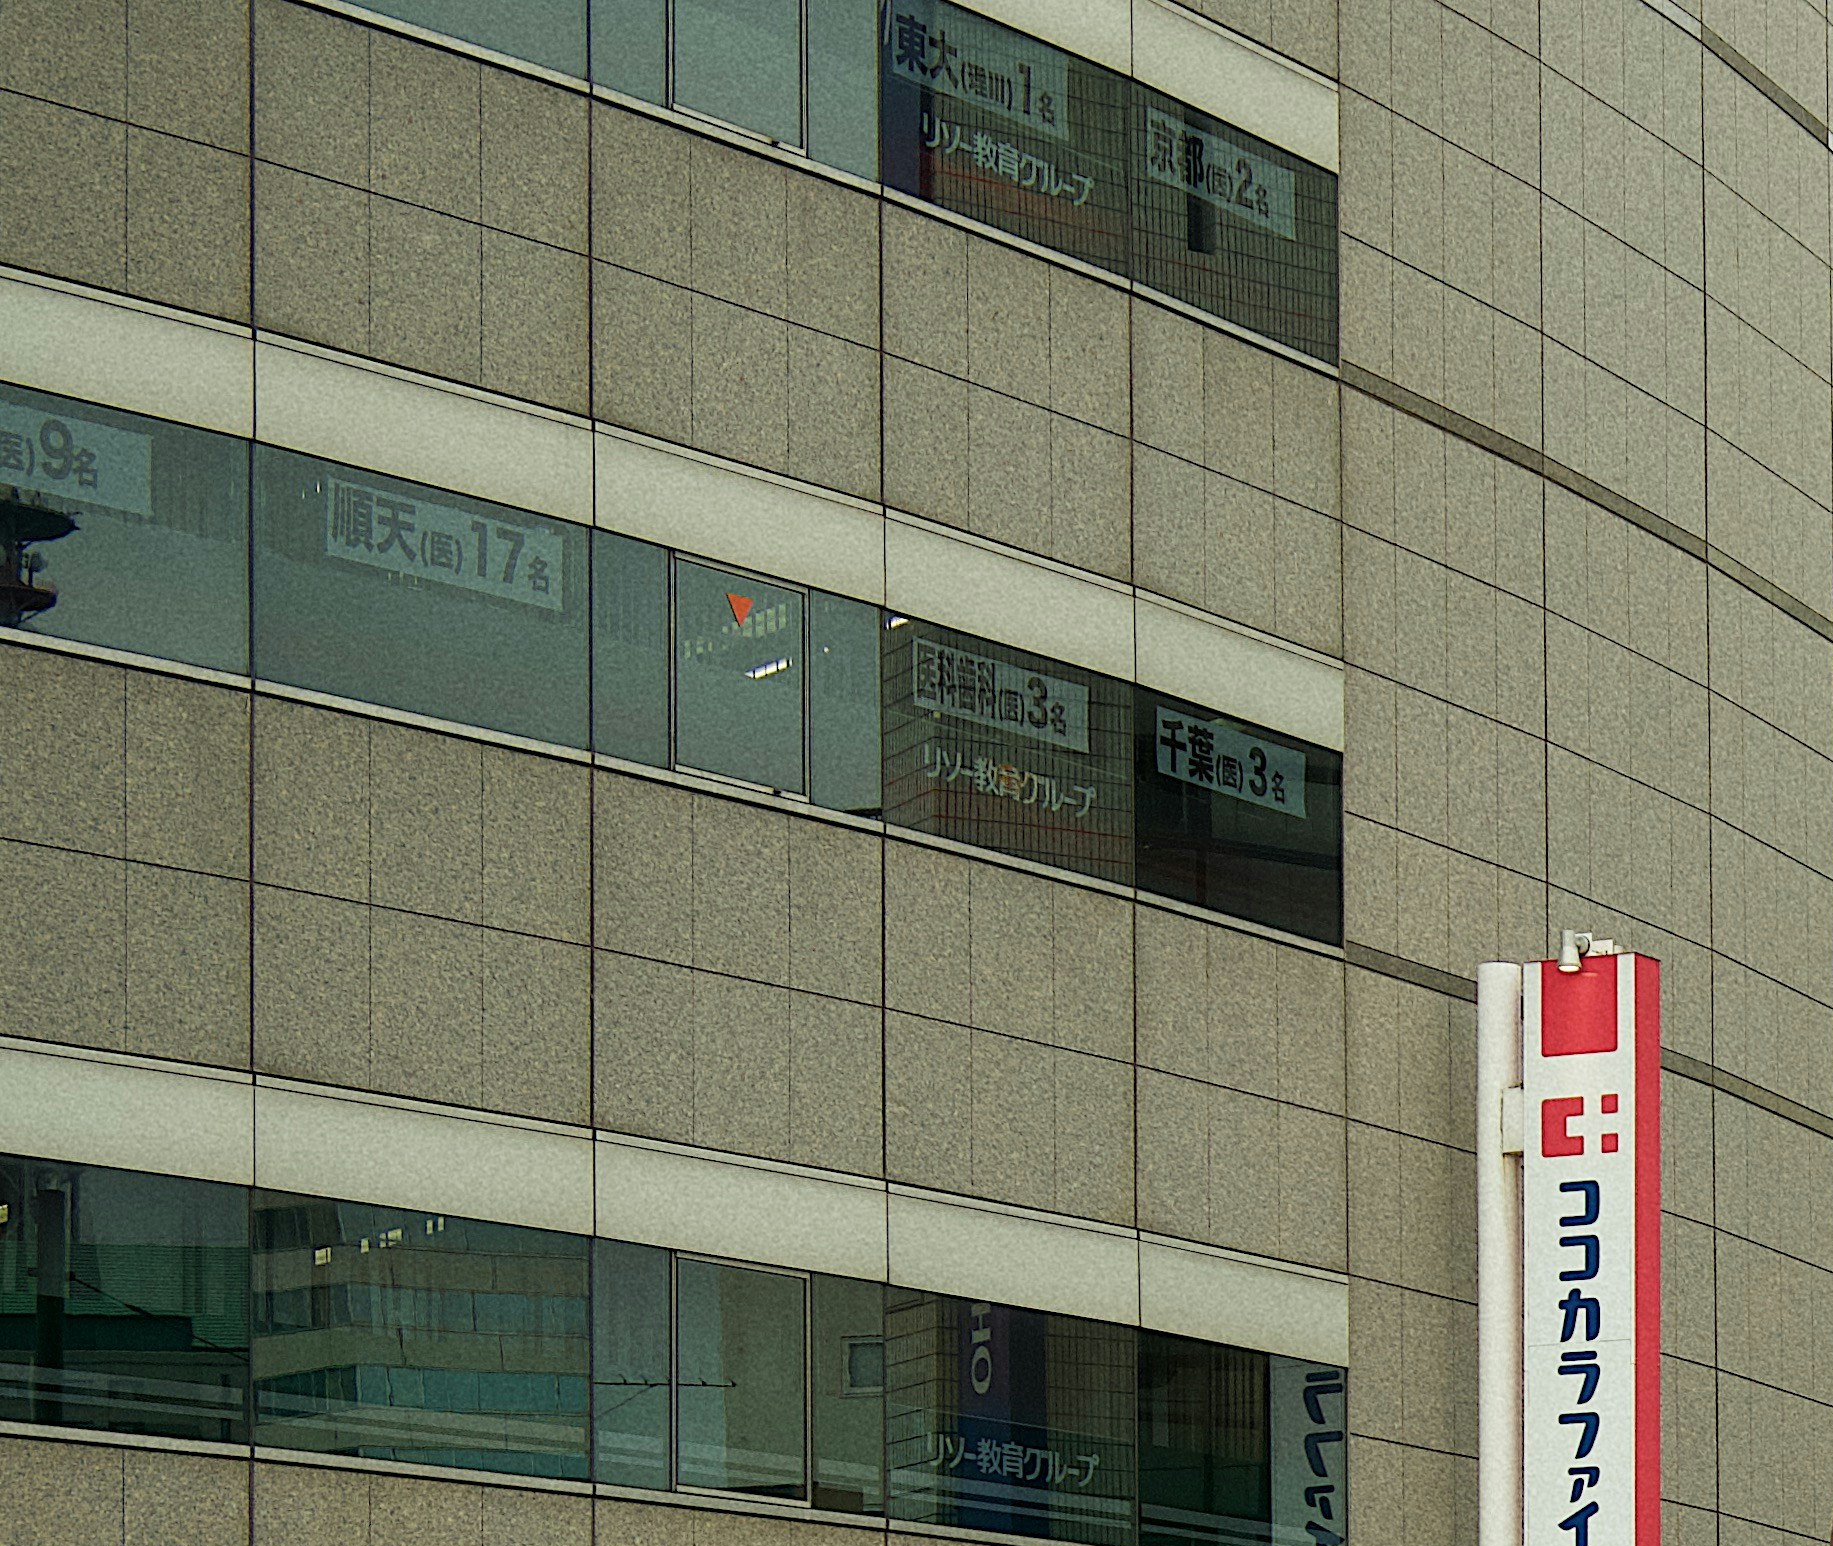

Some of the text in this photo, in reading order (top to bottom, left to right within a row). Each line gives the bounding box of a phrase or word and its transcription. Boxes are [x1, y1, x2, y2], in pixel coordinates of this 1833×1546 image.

[922, 112, 1094, 205] リソー教育グループ
[331, 489, 551, 595] 順天(医)17名
[923, 742, 1097, 819] リソー教育グループ
[1159, 719, 1286, 805] 千葉(医)3名
[926, 1431, 1100, 1488] リソー教育グループ
